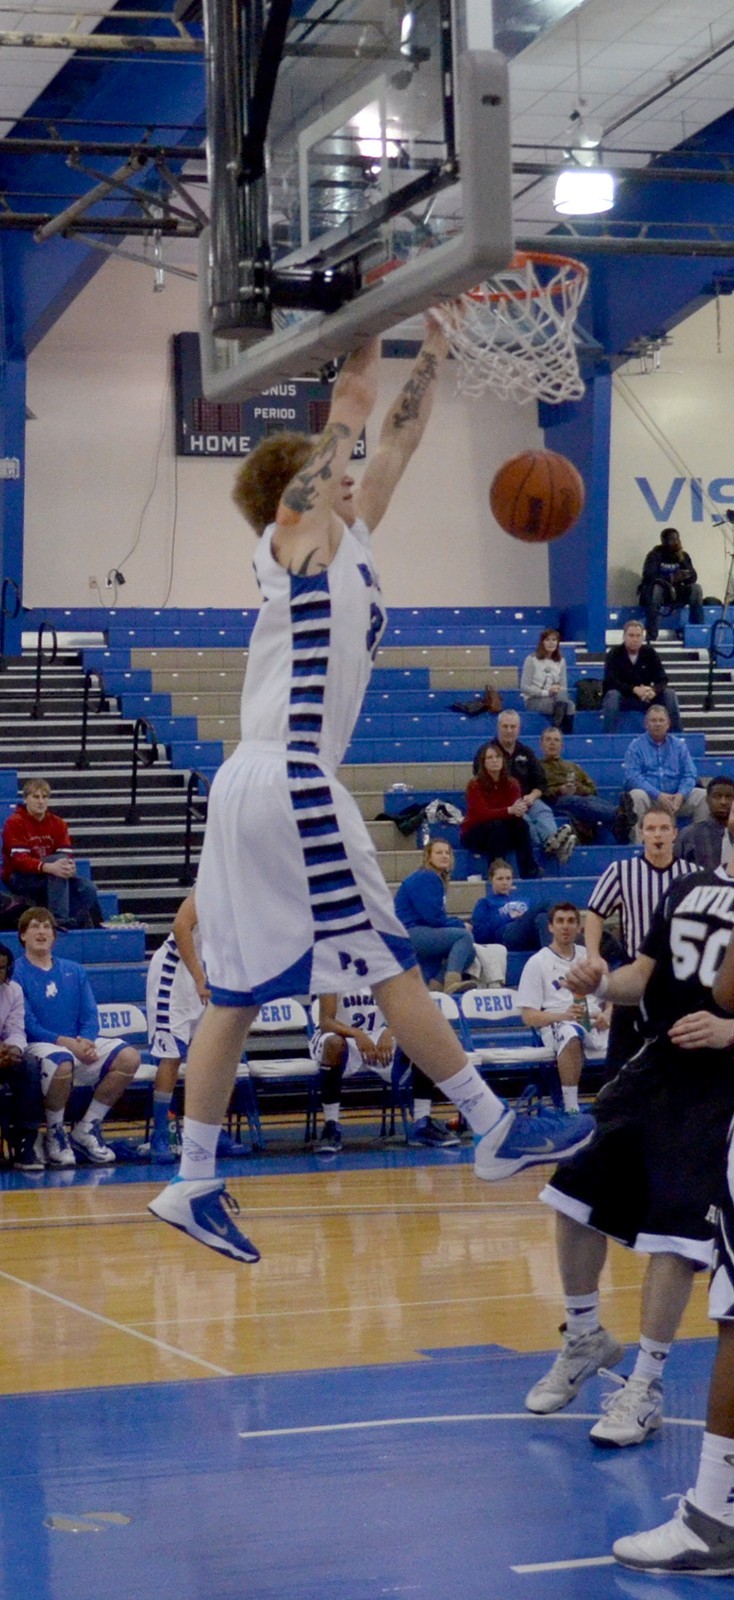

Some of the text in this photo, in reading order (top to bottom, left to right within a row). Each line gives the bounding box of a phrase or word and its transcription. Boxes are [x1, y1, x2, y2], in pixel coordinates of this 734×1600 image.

[261, 384, 297, 397] NUS
[254, 407, 296, 419] PERIOD
[190, 435, 250, 452] HOME
[474, 994, 514, 1012] PERU
[99, 1011, 131, 1028] ERU
[256, 1004, 292, 1022] ERU
[351, 1012, 376, 1031] 21
